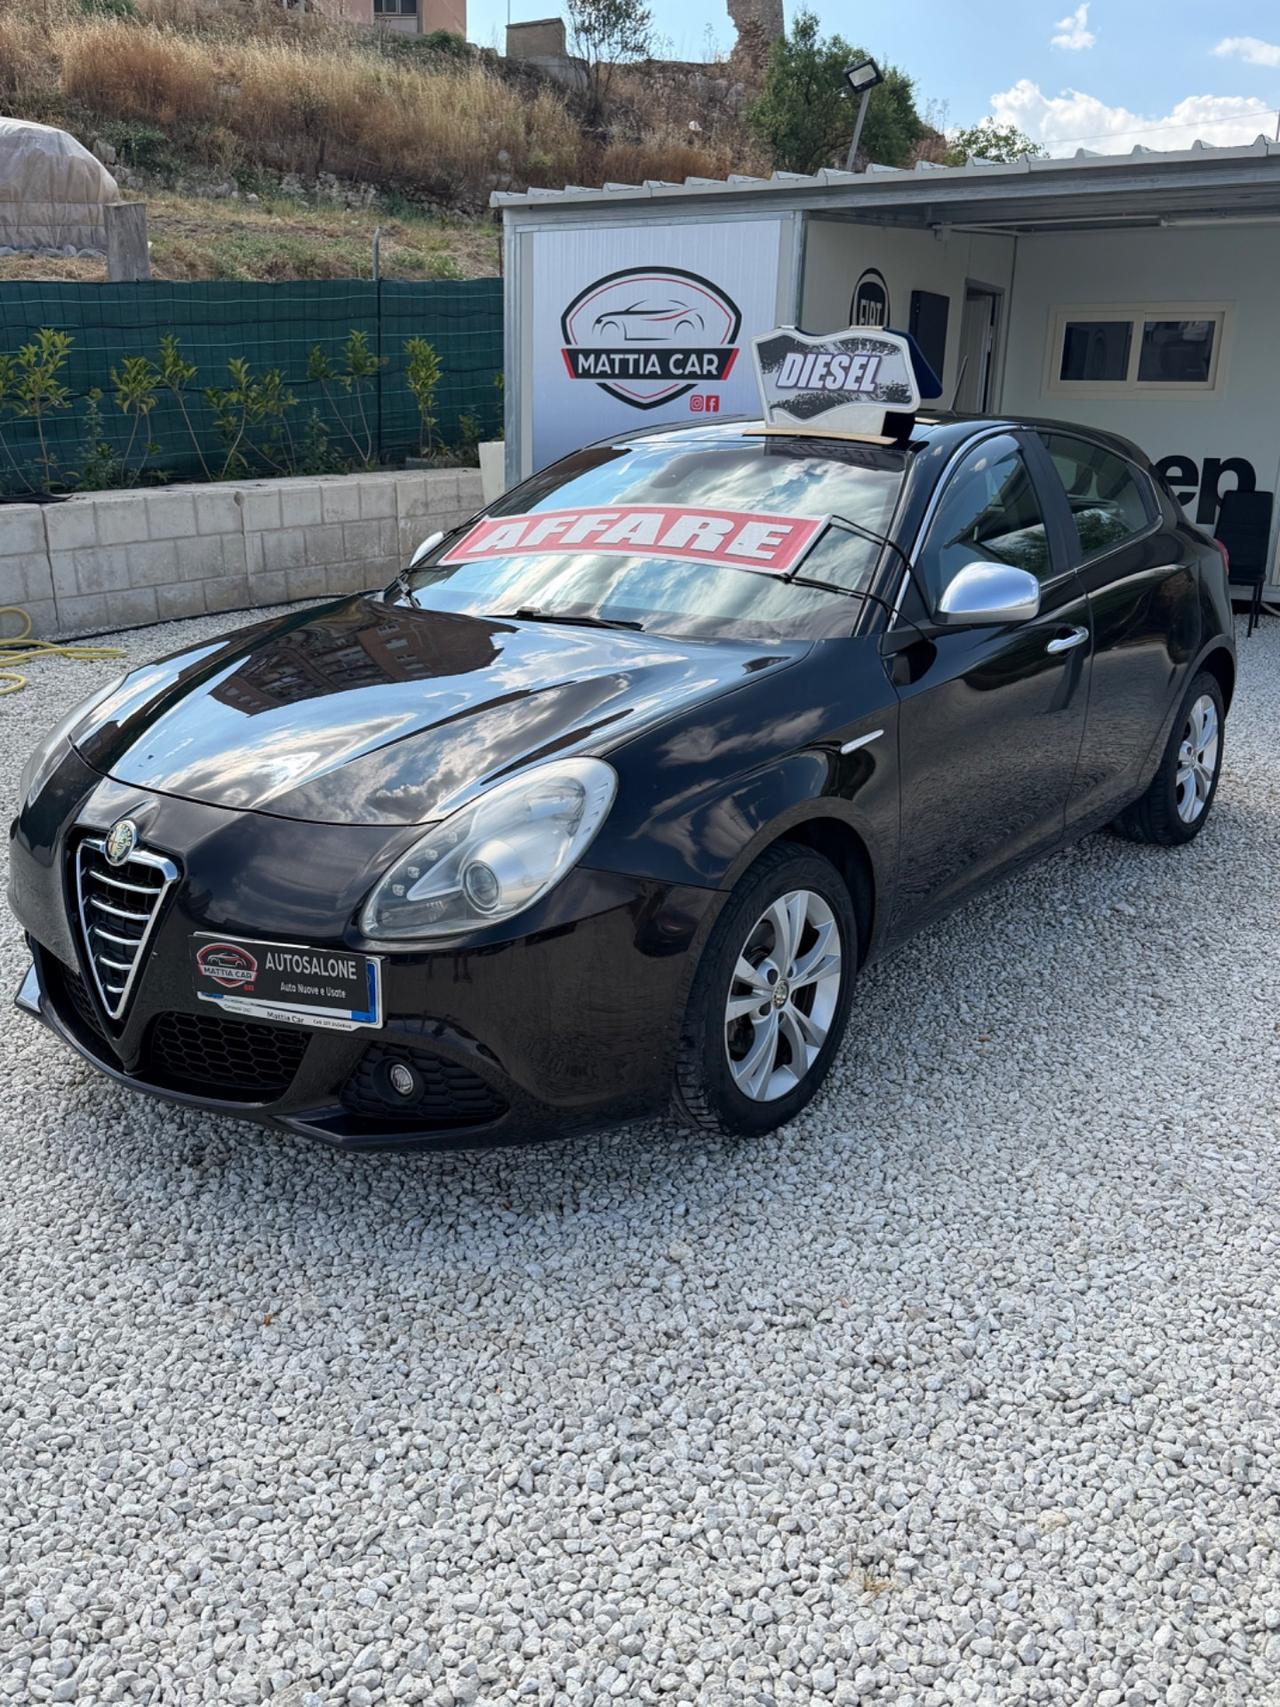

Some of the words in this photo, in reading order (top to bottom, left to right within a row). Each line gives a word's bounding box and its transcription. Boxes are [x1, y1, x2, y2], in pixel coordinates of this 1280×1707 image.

[859, 299, 883, 326] FIAT
[578, 353, 661, 375] MATTIA
[669, 353, 719, 375] CAR
[776, 352, 881, 392] DIESEL
[466, 512, 794, 560] AFFARE
[204, 967, 234, 977] MATTIA
[235, 971, 252, 980] CAR
[265, 951, 357, 980] AUTOSALONE
[280, 981, 296, 993] Auto
[297, 983, 319, 996] Nuove
[326, 986, 346, 999] Usate
[266, 1010, 291, 1023] Mattia
[291, 1014, 304, 1024] Car
